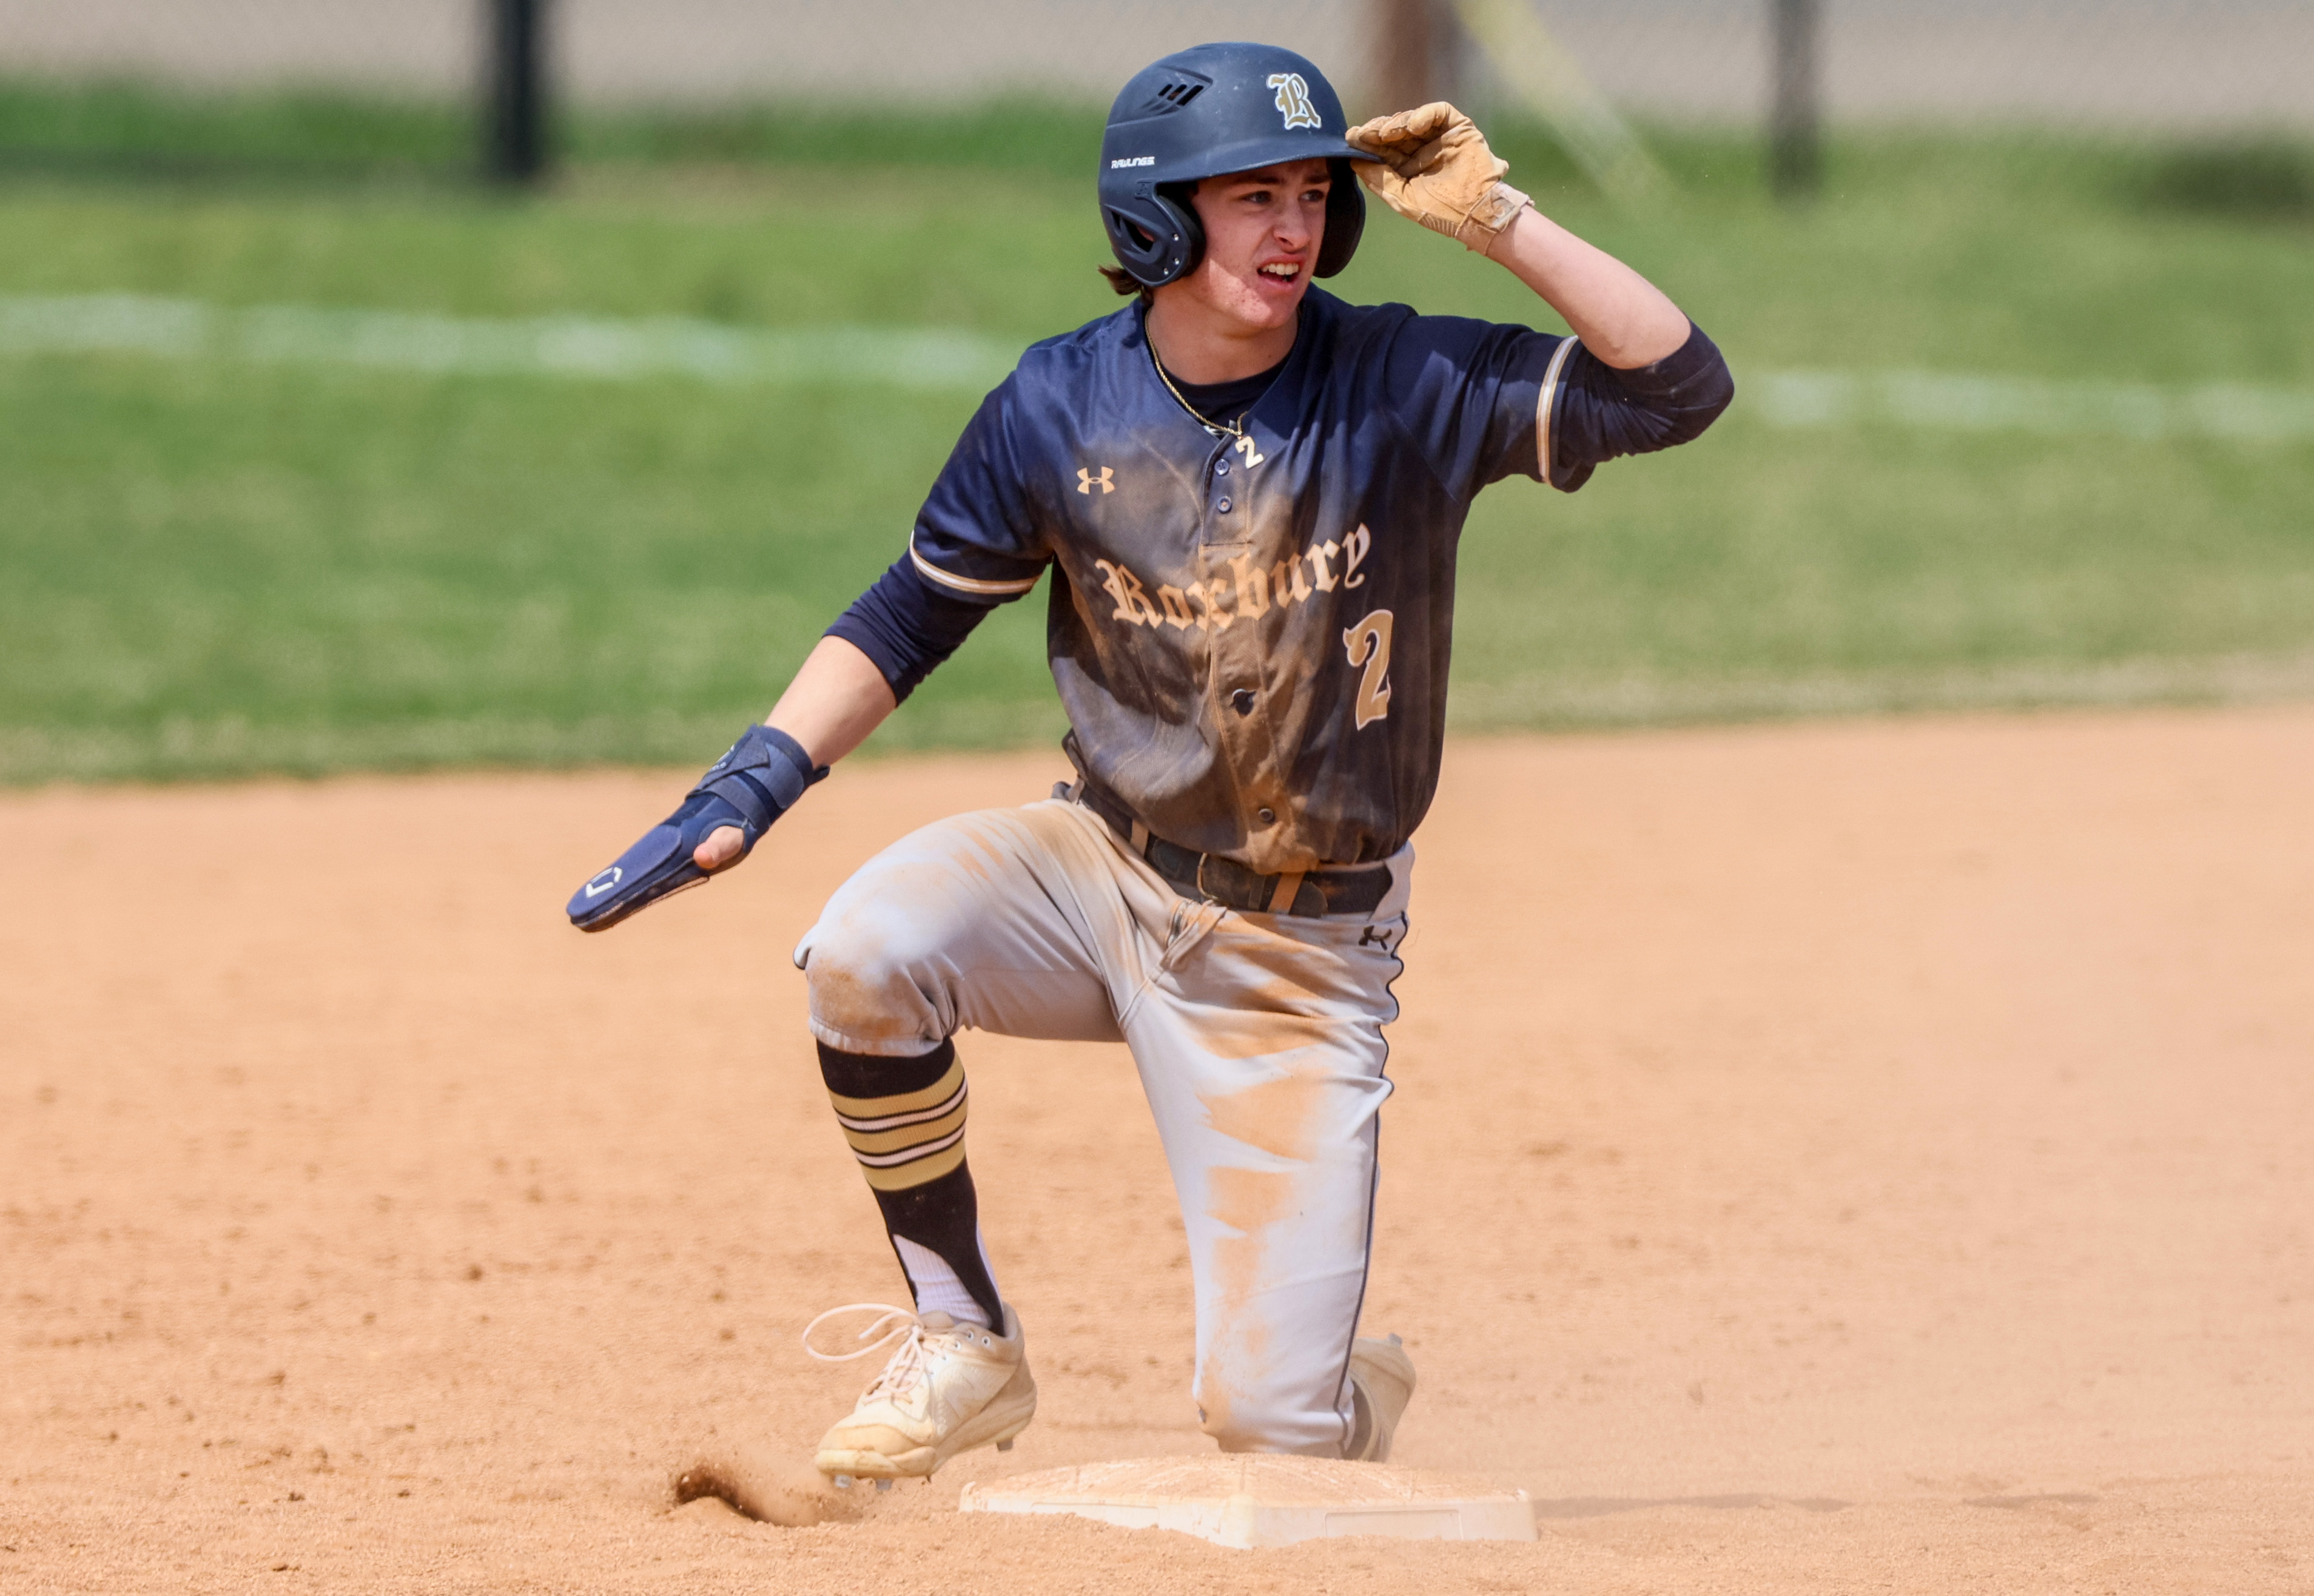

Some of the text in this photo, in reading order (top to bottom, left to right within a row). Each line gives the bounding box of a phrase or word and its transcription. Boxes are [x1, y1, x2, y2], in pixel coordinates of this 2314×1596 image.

[1266, 73, 1321, 129] R
[1111, 156, 1155, 169] RAWLINGS
[1236, 436, 1263, 469] 2
[1095, 523, 1370, 630] Roxbury
[1342, 609, 1393, 731] 2
